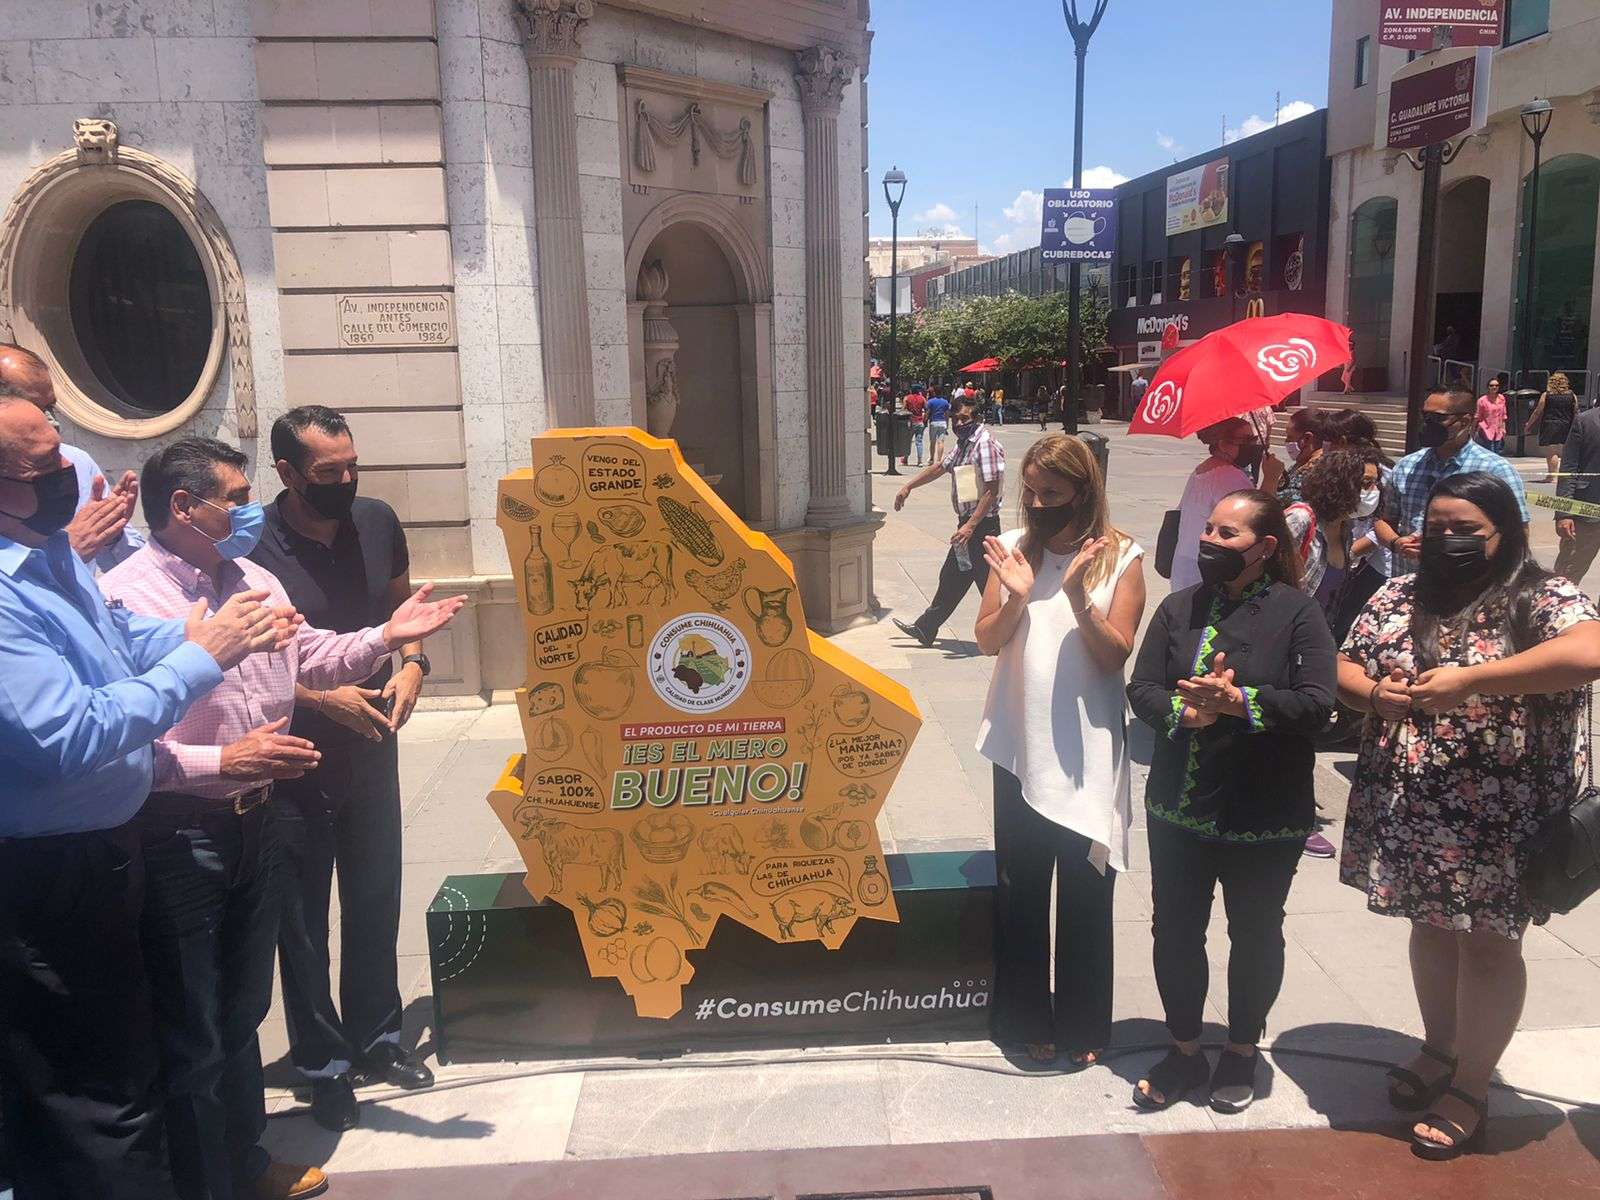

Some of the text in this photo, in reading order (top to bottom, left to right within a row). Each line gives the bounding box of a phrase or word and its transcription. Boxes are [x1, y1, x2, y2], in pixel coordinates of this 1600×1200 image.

[1384, 8, 1498, 21] AV. INDEPENDENCIA
[1398, 101, 1437, 121] GUADALUPE
[1438, 92, 1470, 110] VICTORIA
[1069, 190, 1091, 199] USO
[1047, 199, 1114, 208] OBLIGATORIO
[1042, 250, 1112, 259] CUBREBOCAS
[367, 302, 447, 313] INDEPENDENCIA
[379, 313, 411, 323] ANTES
[343, 322, 448, 333] CALLE DEL COMERCIO
[418, 332, 443, 342] 1984
[586, 454, 641, 466] VENGO DEL
[588, 468, 636, 478] ESTADO
[589, 478, 642, 492] GRANDE
[536, 623, 583, 644] CALIDAD
[660, 619, 737, 648] CONSUME CHIHUAHUA
[543, 645, 558, 653] DEL
[539, 651, 576, 665] NORTE
[665, 686, 687, 704] CALIDAD
[715, 684, 737, 703] MUNDIAL
[624, 720, 783, 737] EL PRODUCTO DE MI TIERRA
[829, 733, 881, 748] ¿LA MEJOR
[839, 738, 902, 754] MANZANA?
[623, 736, 788, 766] ¡ES EL MERO
[874, 749, 901, 759] SABES
[842, 762, 854, 770] DE
[537, 774, 582, 785] SABOR
[559, 786, 595, 797] 100%
[610, 762, 805, 810] BUENO!
[766, 857, 835, 870] PARA RIQUEZAS
[756, 872, 773, 881] LAS
[767, 868, 833, 890] CHIHUAHUA
[695, 987, 989, 1020] #ConsumeChihuahua
